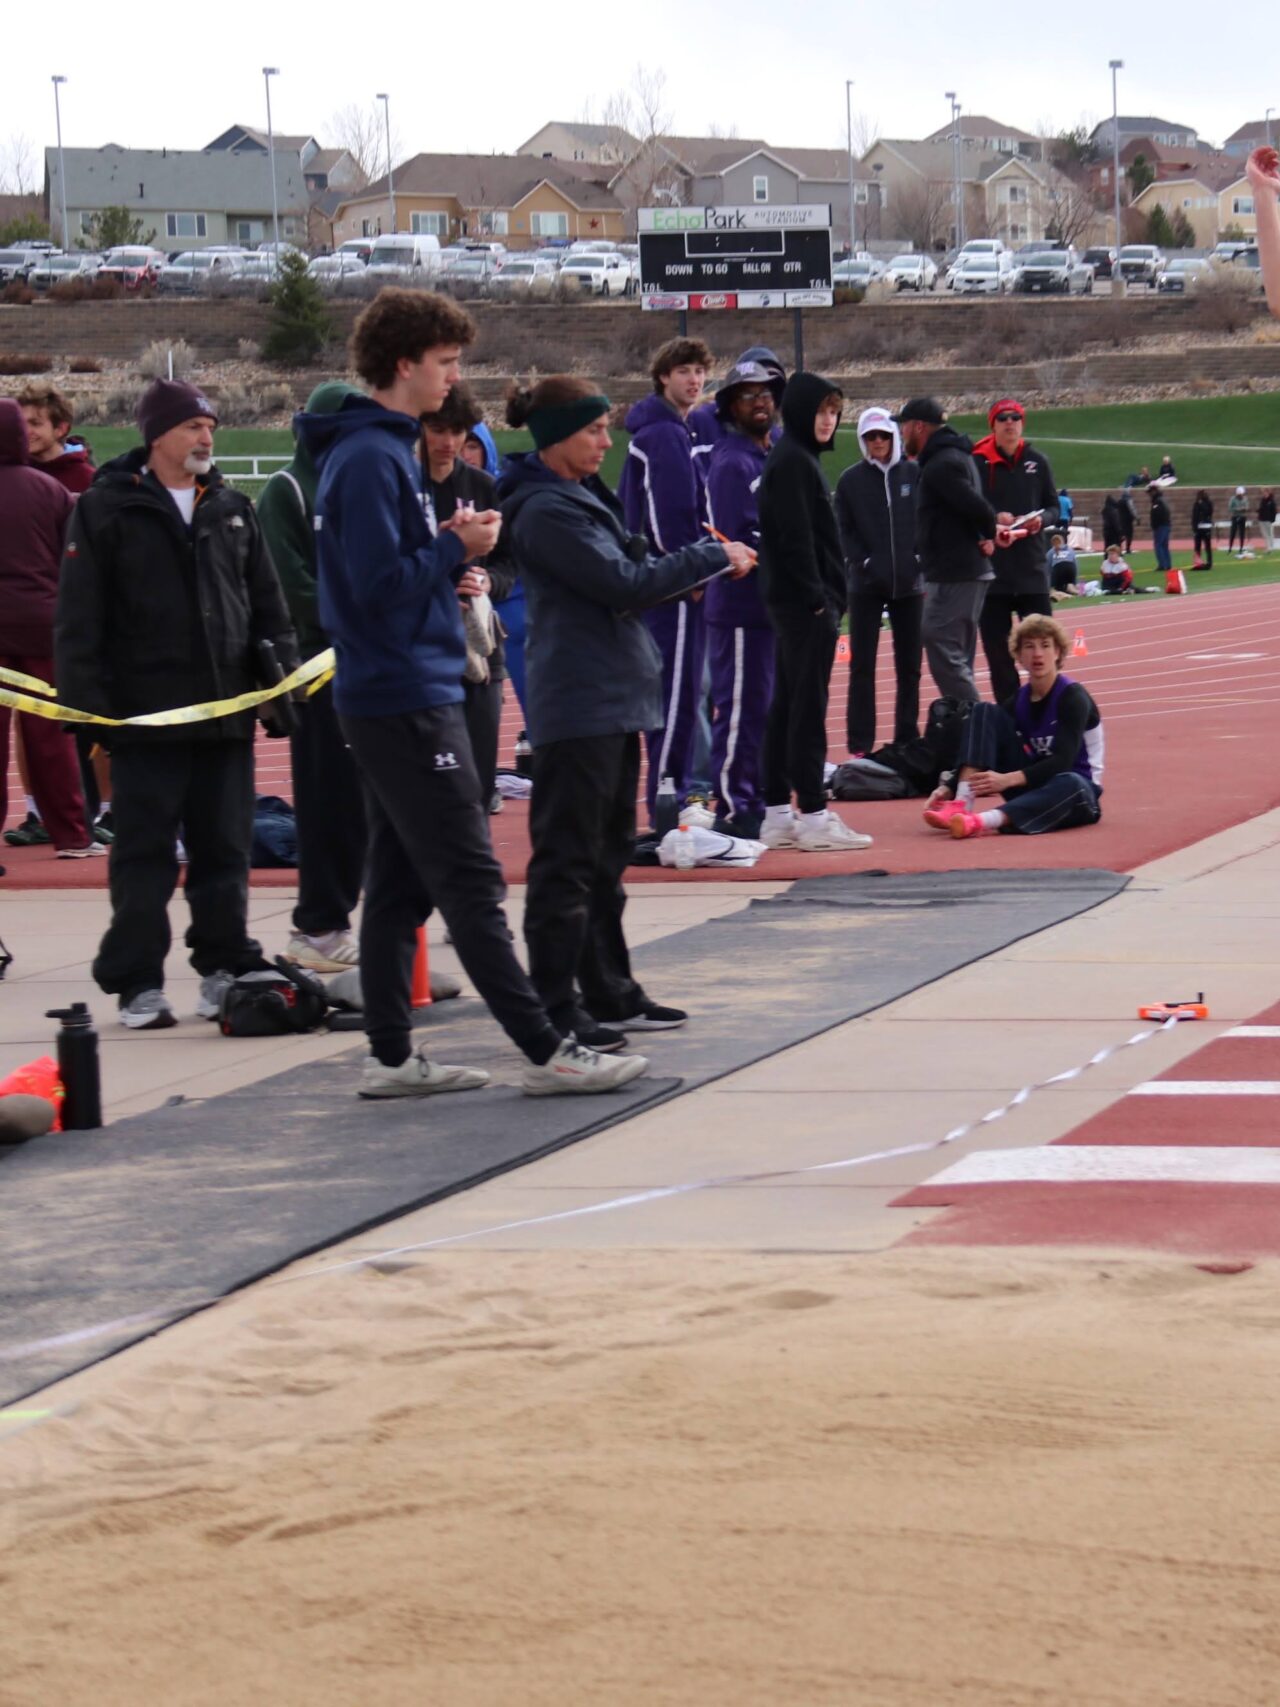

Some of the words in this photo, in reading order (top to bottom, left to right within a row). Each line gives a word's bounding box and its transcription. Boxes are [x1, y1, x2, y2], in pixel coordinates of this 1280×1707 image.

[665, 264, 693, 275] DOWN
[701, 263, 713, 275] TO
[715, 263, 728, 275] GO
[742, 262, 760, 274] BALL
[760, 261, 771, 273] ON
